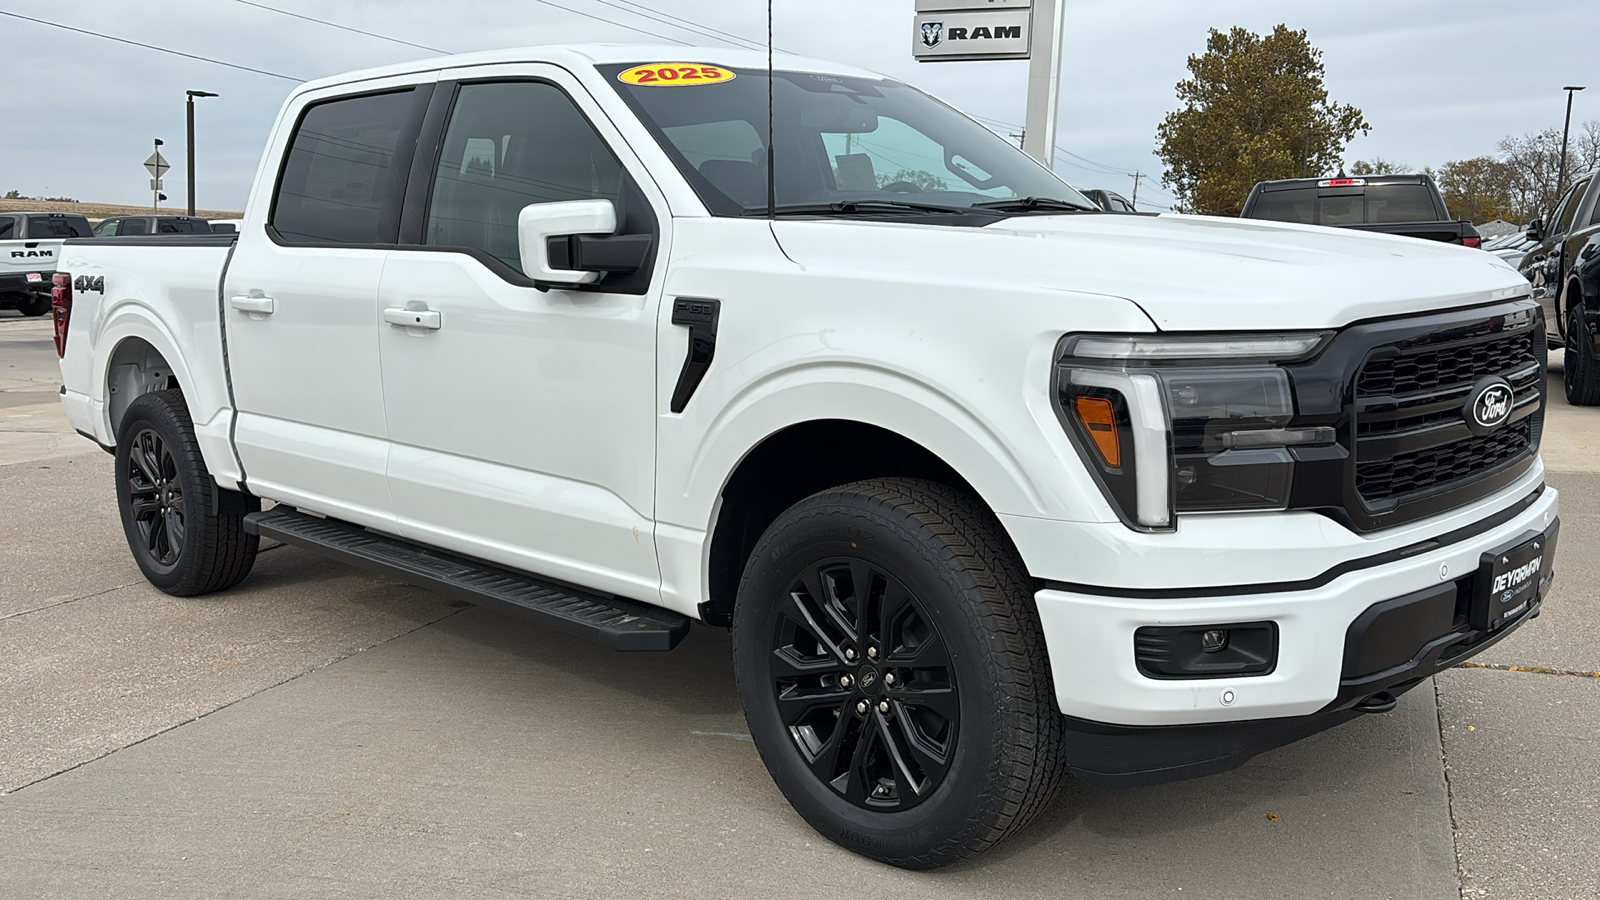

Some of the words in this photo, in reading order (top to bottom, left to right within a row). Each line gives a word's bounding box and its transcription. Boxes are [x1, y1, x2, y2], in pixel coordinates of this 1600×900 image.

[948, 26, 1021, 40] RAM
[634, 67, 722, 83] 2025
[11, 250, 53, 258] RAM
[675, 302, 712, 316] F-150
[1481, 389, 1508, 421] Ford
[1492, 555, 1542, 595] DEYARMAN
